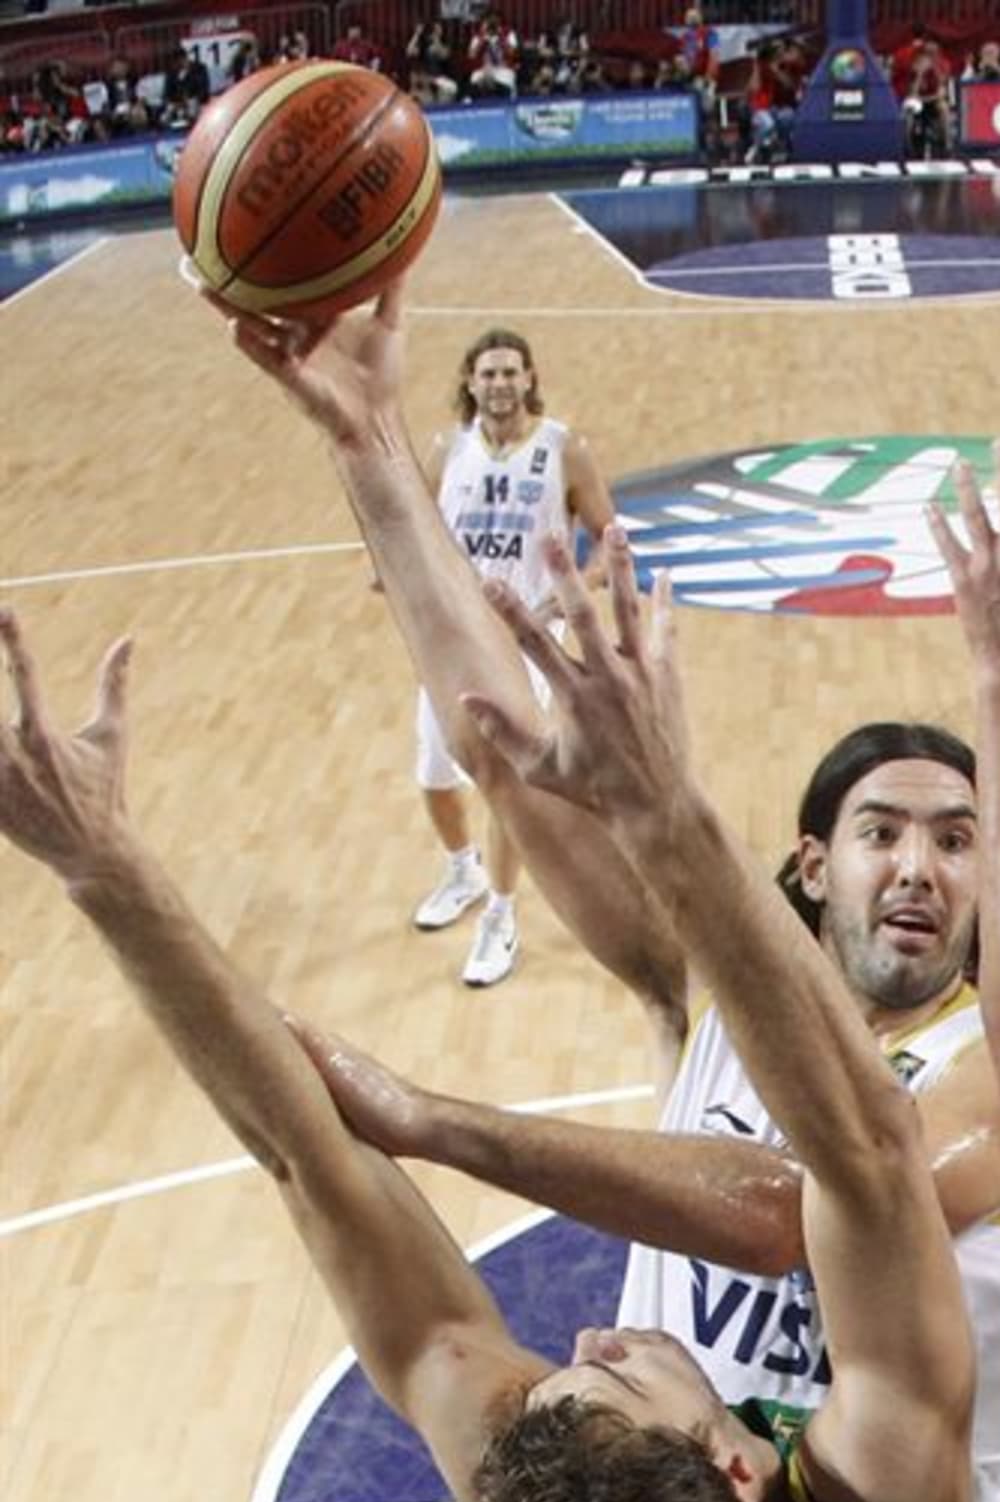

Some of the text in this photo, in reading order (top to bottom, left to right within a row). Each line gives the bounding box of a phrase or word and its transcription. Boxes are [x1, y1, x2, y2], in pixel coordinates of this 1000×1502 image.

[336, 144, 405, 217] FIBA
[484, 475, 509, 505] 14
[464, 533, 523, 560] VISA
[688, 1259, 833, 1386] VIS
